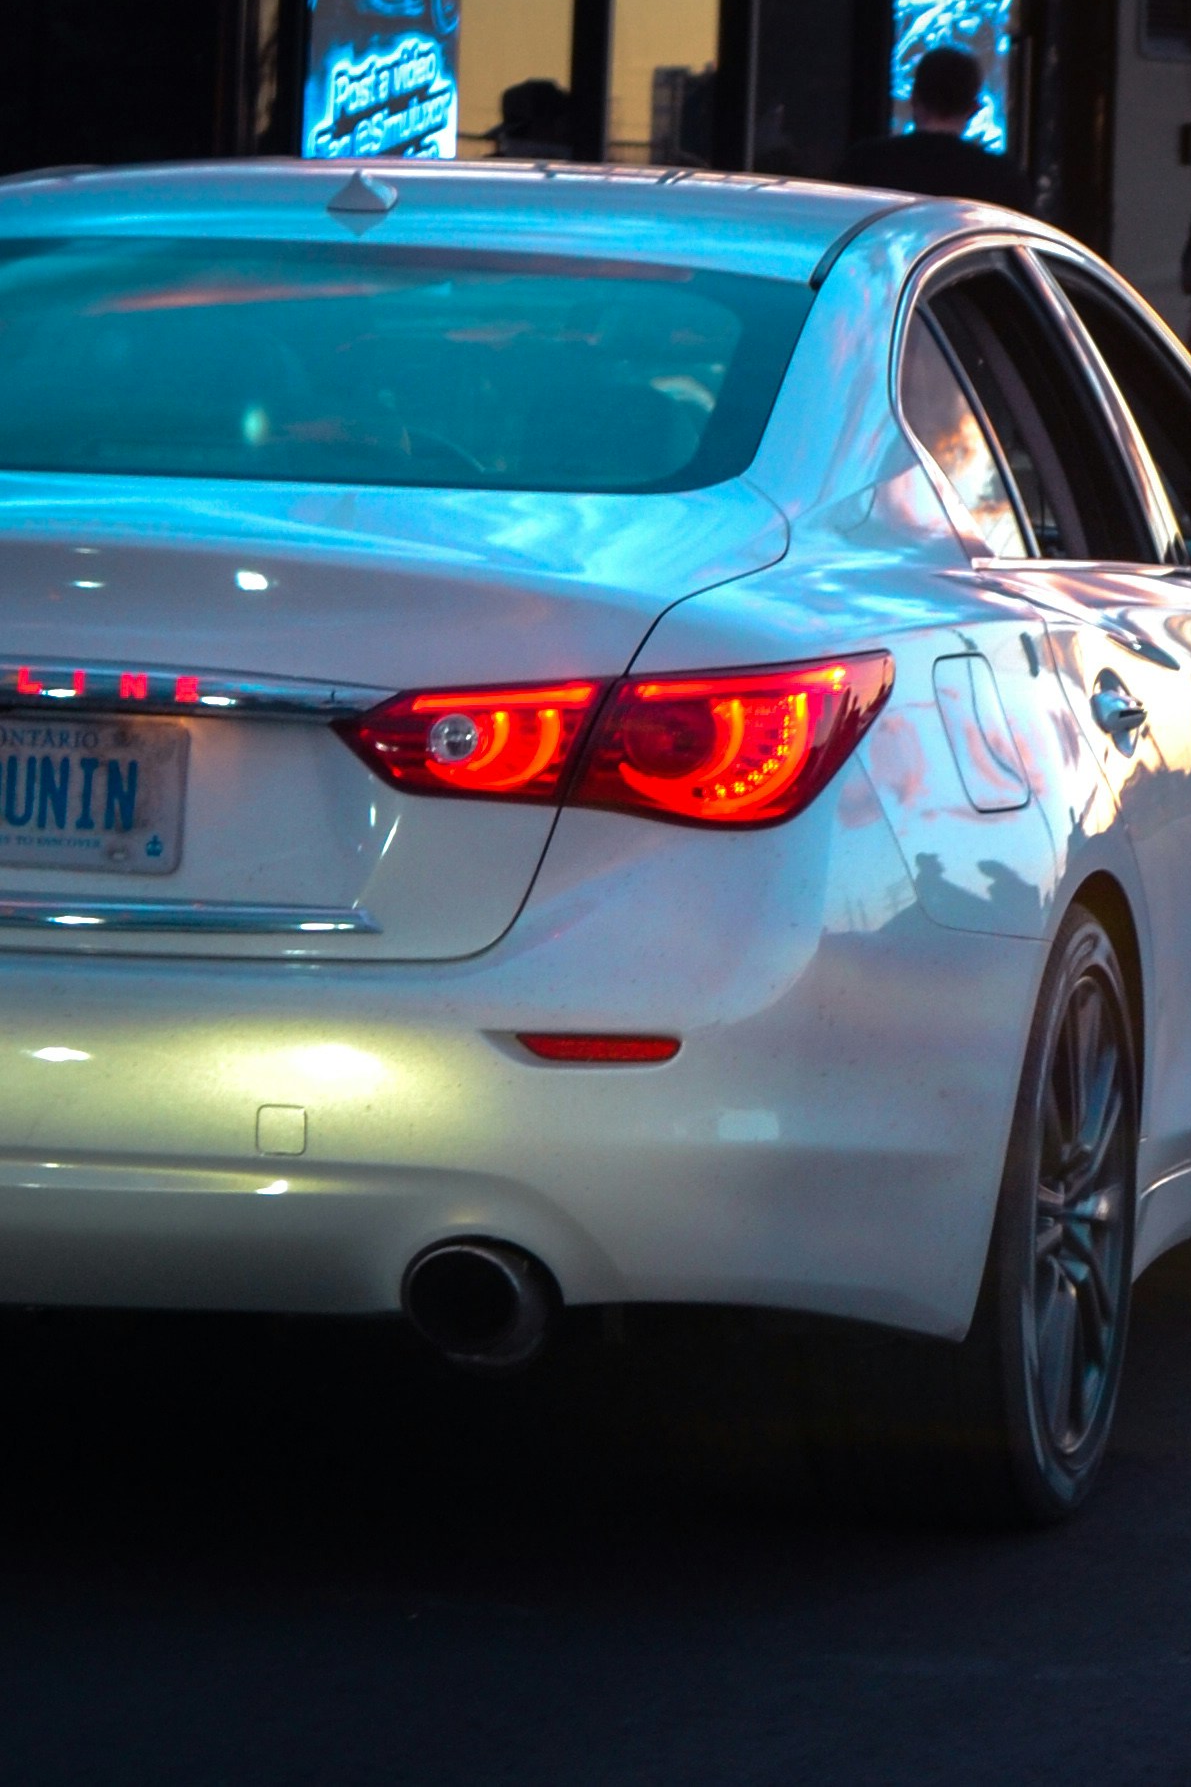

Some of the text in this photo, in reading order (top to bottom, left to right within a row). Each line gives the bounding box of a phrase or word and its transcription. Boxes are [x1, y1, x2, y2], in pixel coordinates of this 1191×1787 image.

[335, 44, 436, 111] Post a video
[17, 666, 200, 703] LINE
[0, 756, 138, 832] UNIN
